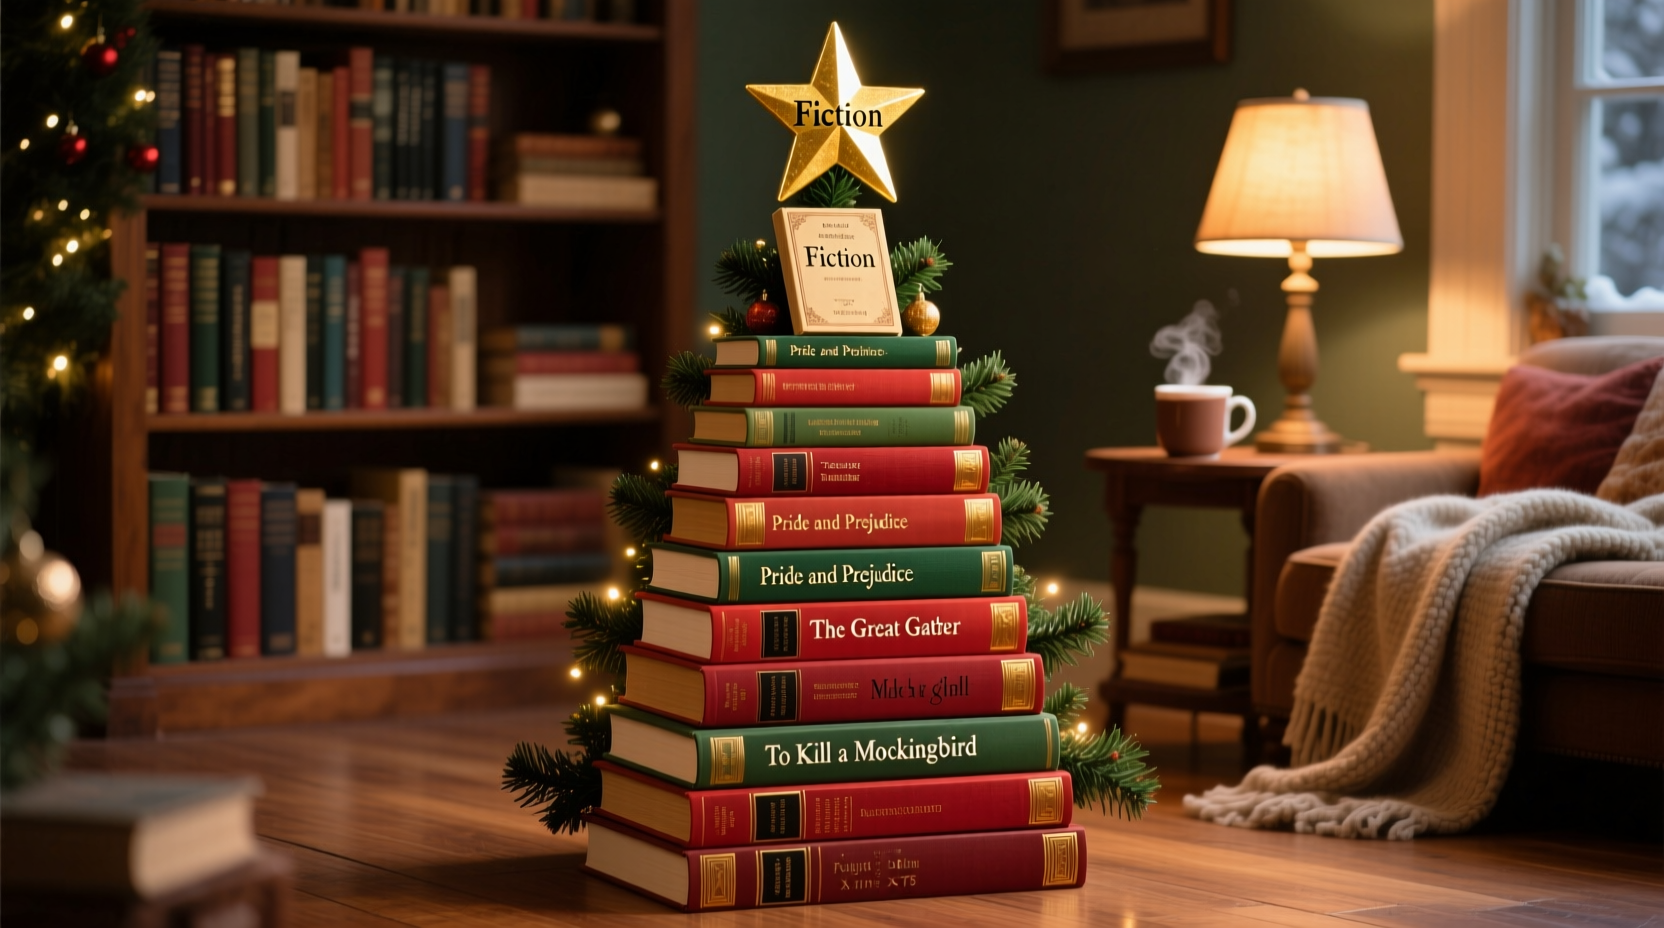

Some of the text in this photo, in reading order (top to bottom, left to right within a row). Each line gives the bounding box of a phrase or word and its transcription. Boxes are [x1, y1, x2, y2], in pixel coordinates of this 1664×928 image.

[793, 100, 883, 127] Fiction
[803, 245, 876, 268] Fiction
[820, 345, 839, 356] and
[772, 512, 909, 535] Pride and Prejudice
[760, 563, 914, 590] Pride and Prejudice
[809, 618, 846, 640] The
[850, 617, 901, 638] Great
[765, 734, 977, 766] To Kill a Mockingbird
